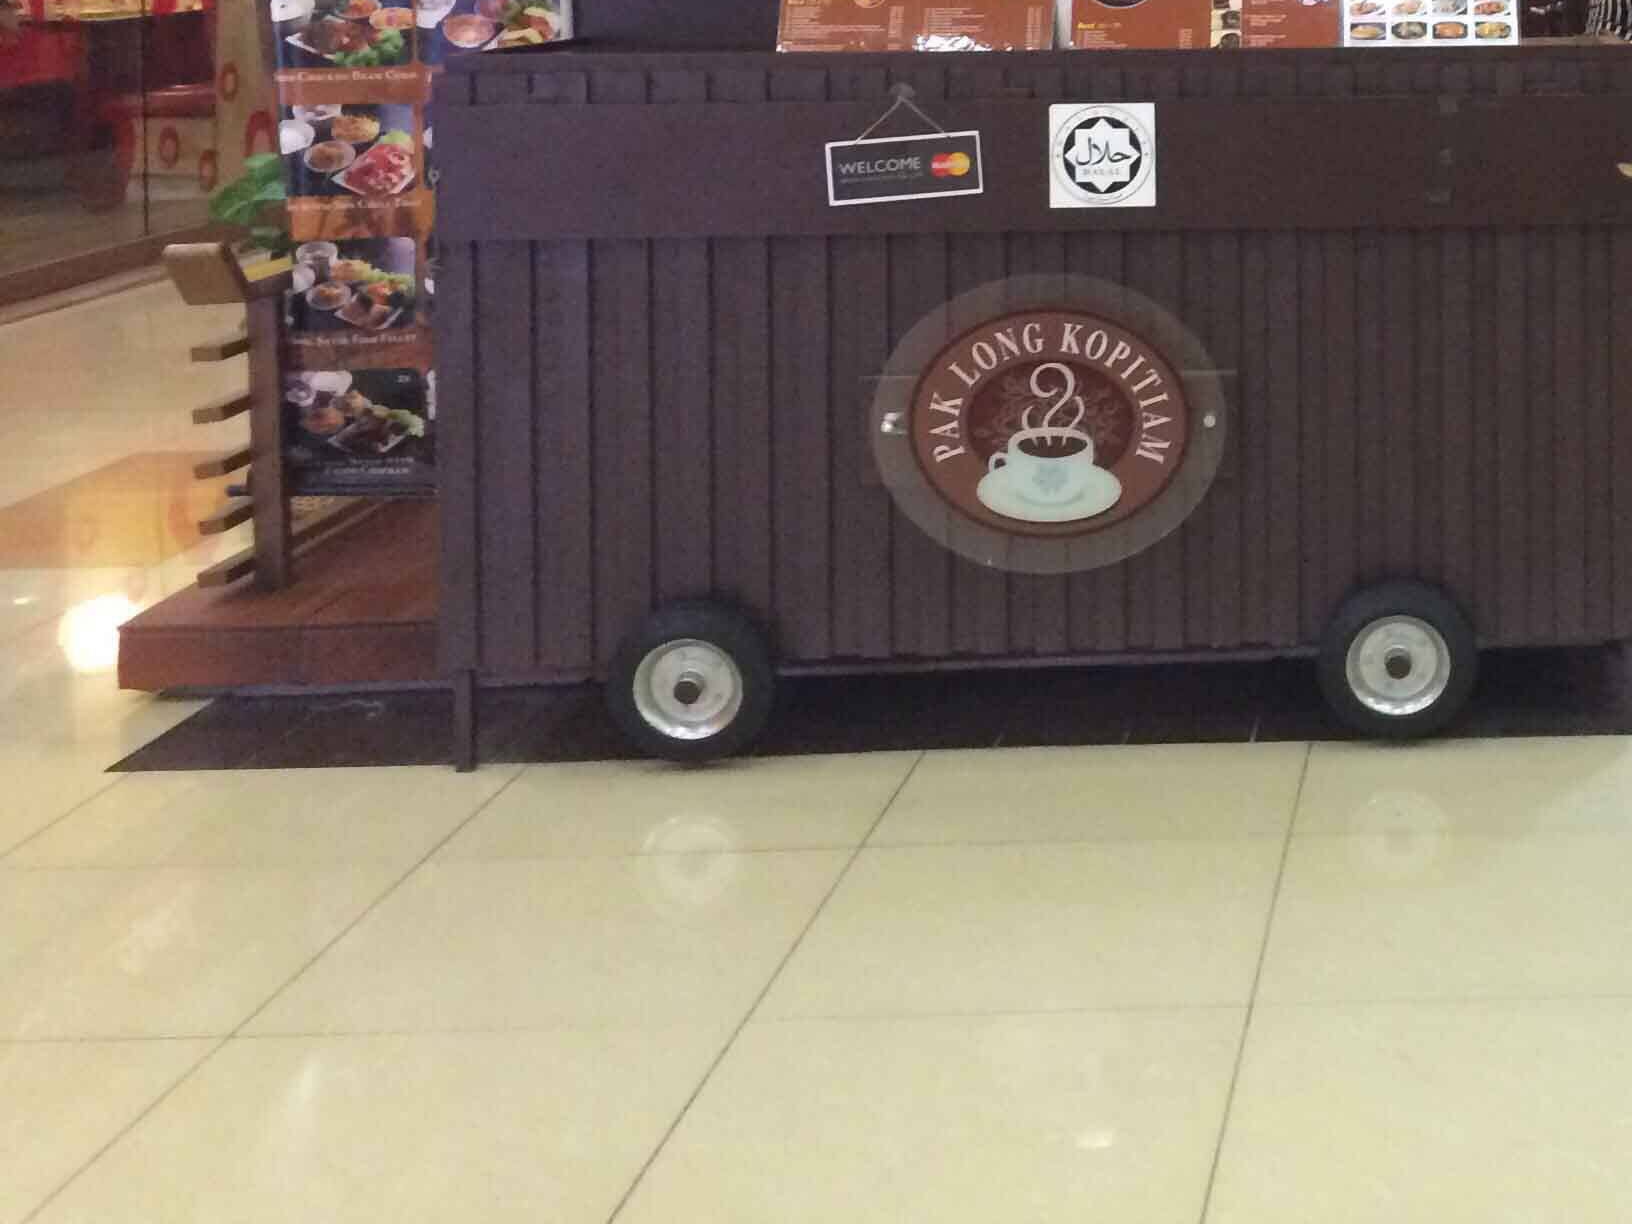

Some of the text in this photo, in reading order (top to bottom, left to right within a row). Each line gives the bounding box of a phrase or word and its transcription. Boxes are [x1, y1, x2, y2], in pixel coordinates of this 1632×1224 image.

[839, 156, 921, 175] WELCOME
[928, 322, 1173, 465] PAK LONG KOPITIAM
